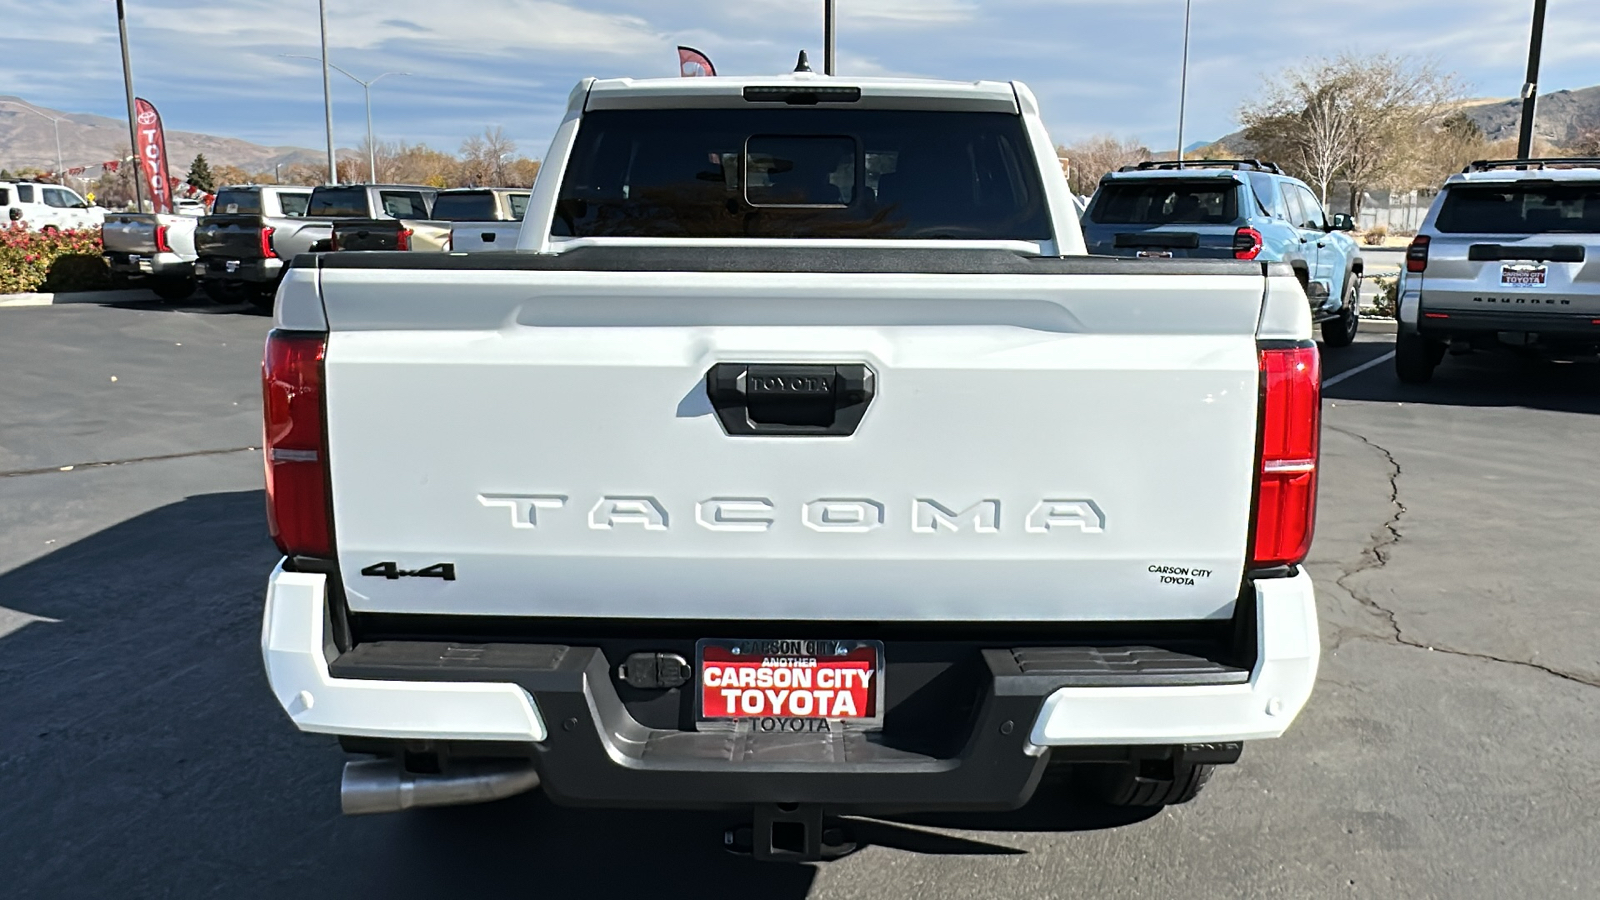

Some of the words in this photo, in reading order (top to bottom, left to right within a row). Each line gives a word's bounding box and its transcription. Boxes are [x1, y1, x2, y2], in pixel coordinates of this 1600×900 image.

[751, 377, 830, 391] TOYOTA
[477, 492, 1107, 534] TACOMA
[1148, 565, 1189, 575] CARSON
[1191, 569, 1212, 577] CITY
[1160, 576, 1194, 585] TOYOTA
[741, 640, 801, 655] CARSON
[805, 640, 841, 655] CITY
[761, 657, 817, 668] ANOTHER
[703, 667, 812, 688] CARSON
[817, 668, 875, 688] CITY
[721, 689, 857, 716] TOYOTA
[752, 717, 830, 732] TOYOTA
